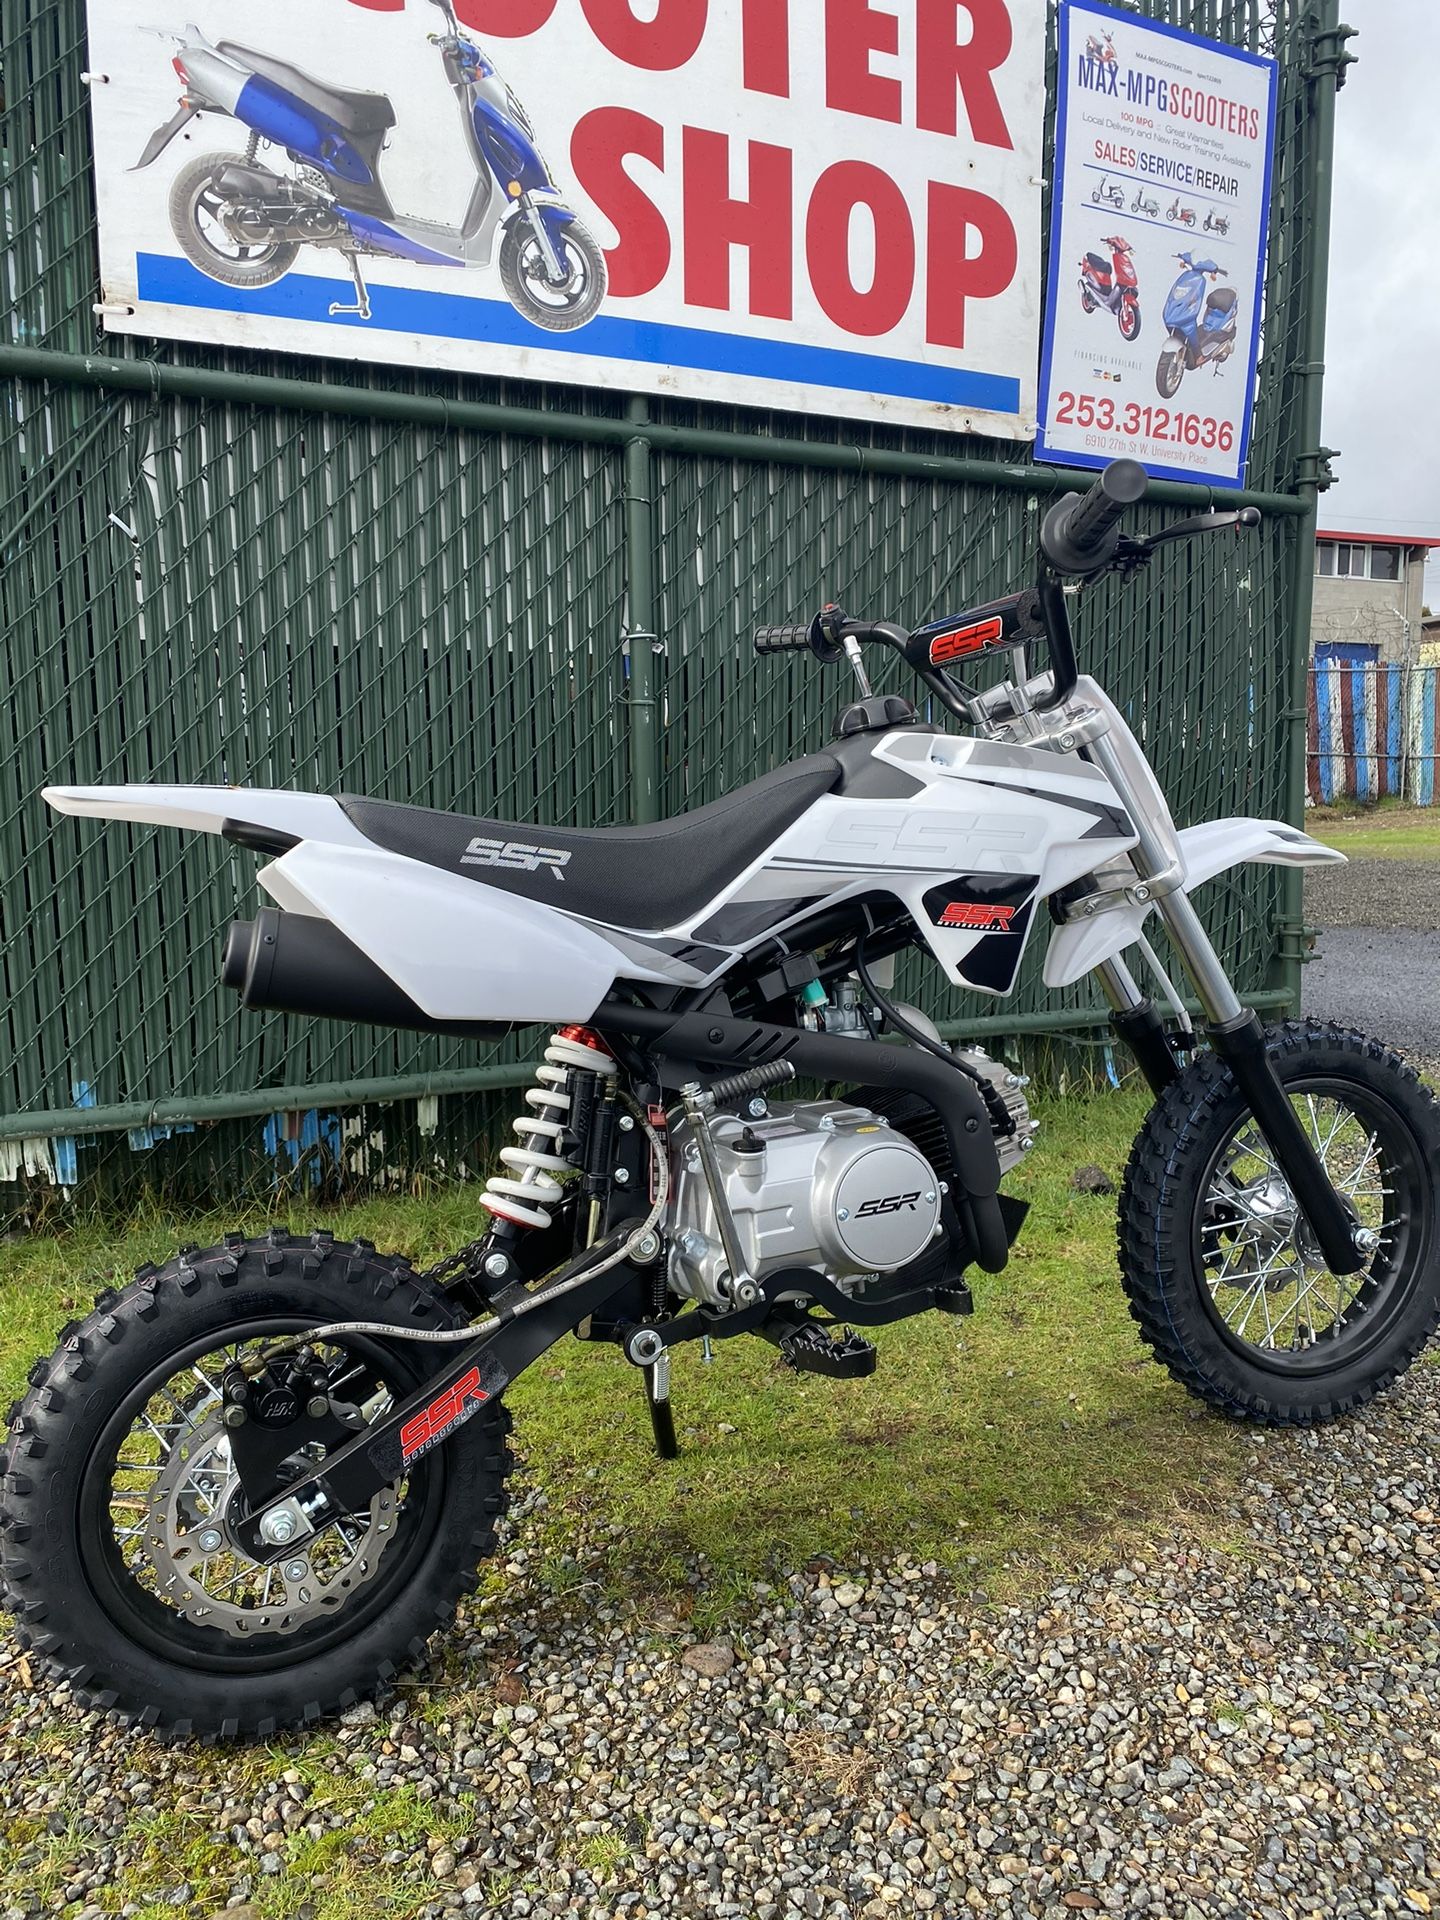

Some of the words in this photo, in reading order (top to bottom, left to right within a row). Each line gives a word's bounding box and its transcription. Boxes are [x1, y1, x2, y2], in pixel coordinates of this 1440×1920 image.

[348, 0, 1014, 150] TER
[1077, 54, 1260, 141] MAX-MPGSCOOTERS
[1082, 112, 1104, 126] Local
[1105, 119, 1135, 136] Delivery
[1136, 128, 1152, 140] and
[1153, 133, 1170, 146] New
[1173, 138, 1192, 151] Rider
[1193, 143, 1220, 162] Training
[1222, 153, 1252, 170] Available
[1120, 112, 1134, 123] 100
[1136, 116, 1154, 129] MPG
[1165, 124, 1185, 138] Great
[570, 105, 1018, 349] SHOP
[1056, 391, 1234, 452] 253.312.1636
[1085, 434, 1106, 448] 6910
[1109, 437, 1126, 450] 27th
[1128, 441, 1137, 454] St
[1139, 443, 1149, 455] W.
[1151, 445, 1187, 463] University
[1188, 451, 1208, 465] Place
[929, 615, 1008, 665] SSR
[460, 837, 572, 880] SSR
[814, 808, 1050, 874] SSR
[936, 920, 1002, 931] MOTORSPORTS
[940, 902, 1015, 931] SSR
[854, 1191, 922, 1219] SSR
[400, 1366, 490, 1458] SSR
[403, 1399, 480, 1466] MOTORSPORTS
